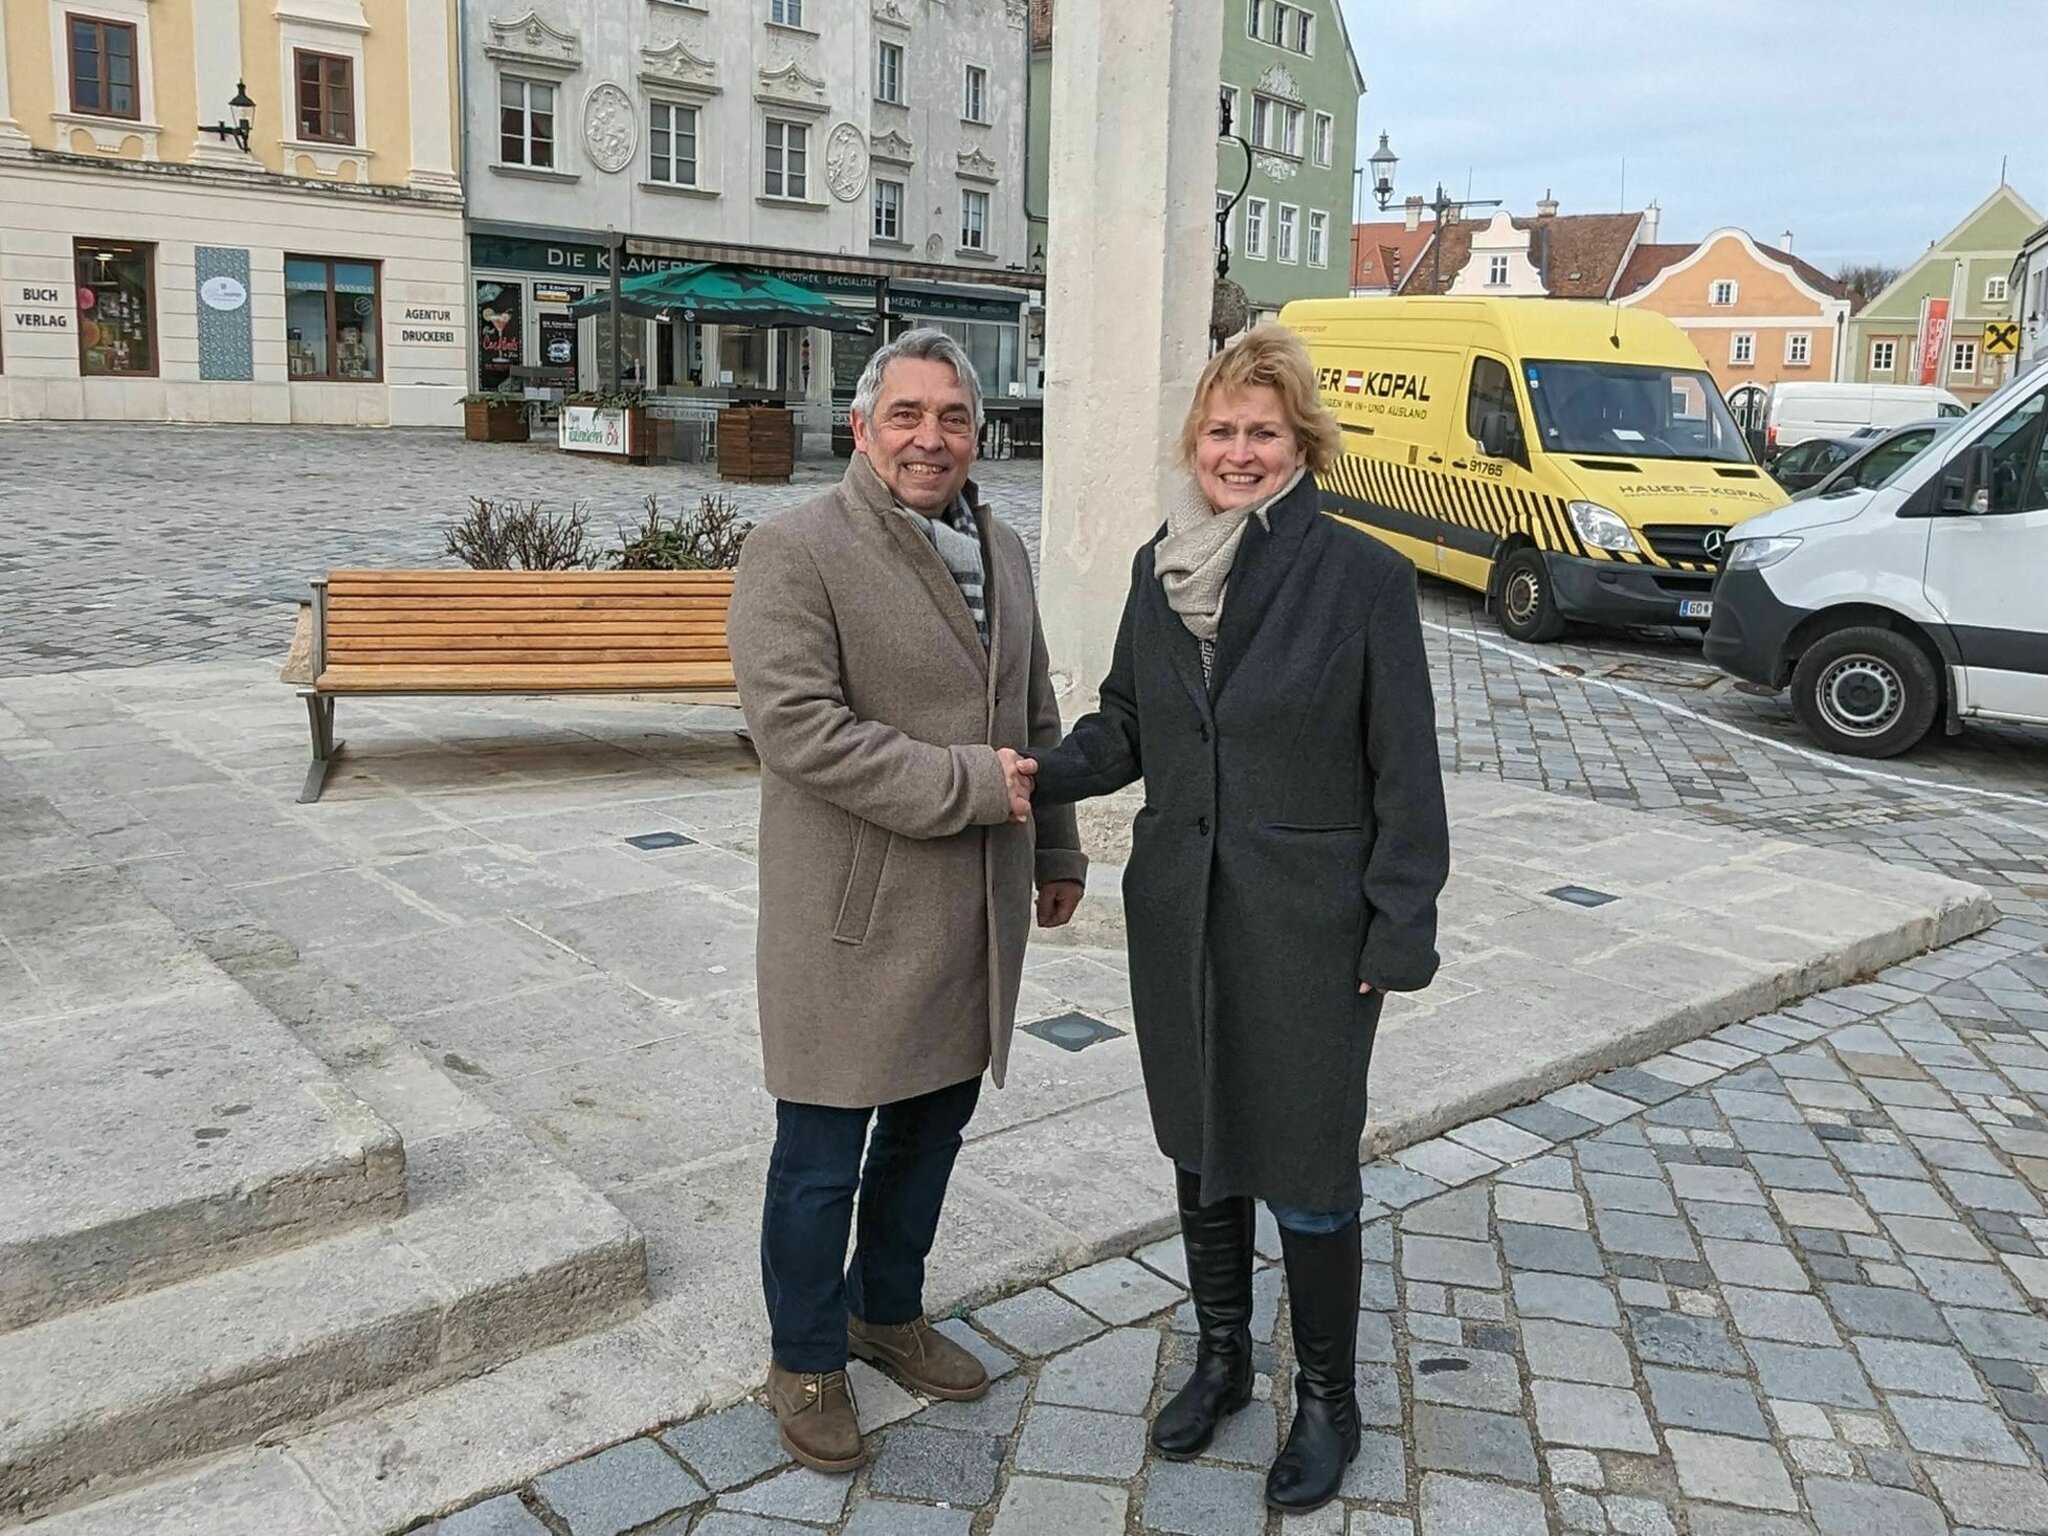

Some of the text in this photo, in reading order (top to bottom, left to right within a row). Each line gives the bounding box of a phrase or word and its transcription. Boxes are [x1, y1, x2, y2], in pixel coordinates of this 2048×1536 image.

[547, 248, 697, 273] DIE KAMER
[777, 271, 820, 283] VINOTHEK
[827, 275, 889, 288] SPECIALITÄT
[23, 288, 58, 302] BUCH
[15, 313, 68, 327] VERLAG
[405, 308, 451, 321] AGENTUR
[402, 330, 454, 343] DRUCKEREI
[1315, 367, 1431, 402] ER KOPAL
[1387, 405, 1428, 420] AUSLAND
[1469, 460, 1503, 477] 91765
[1619, 485, 1686, 493] HAUER
[1710, 487, 1771, 501] KOPAL
